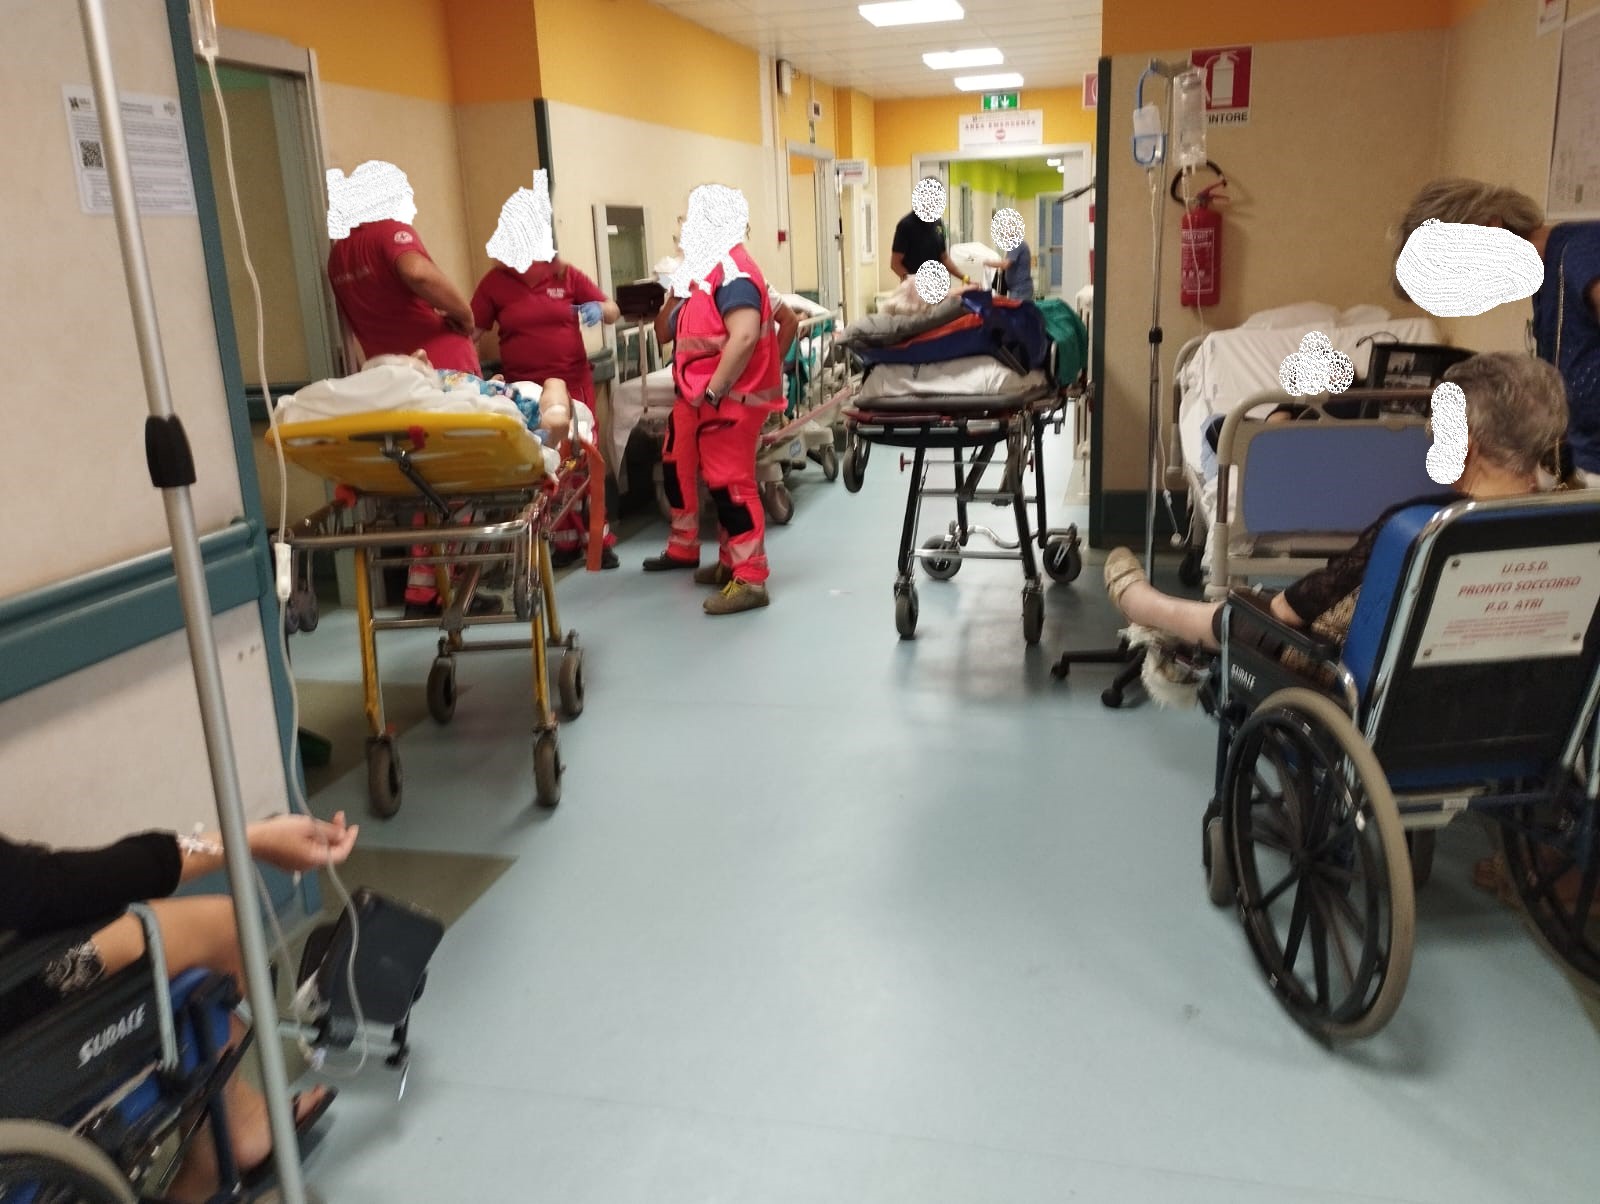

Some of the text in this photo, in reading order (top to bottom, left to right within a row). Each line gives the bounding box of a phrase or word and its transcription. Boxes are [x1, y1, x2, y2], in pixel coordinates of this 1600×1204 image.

[1207, 112, 1248, 123] INTORE
[1458, 576, 1582, 597] PRONTO SOCCORSO
[1514, 598, 1544, 609] ATRI
